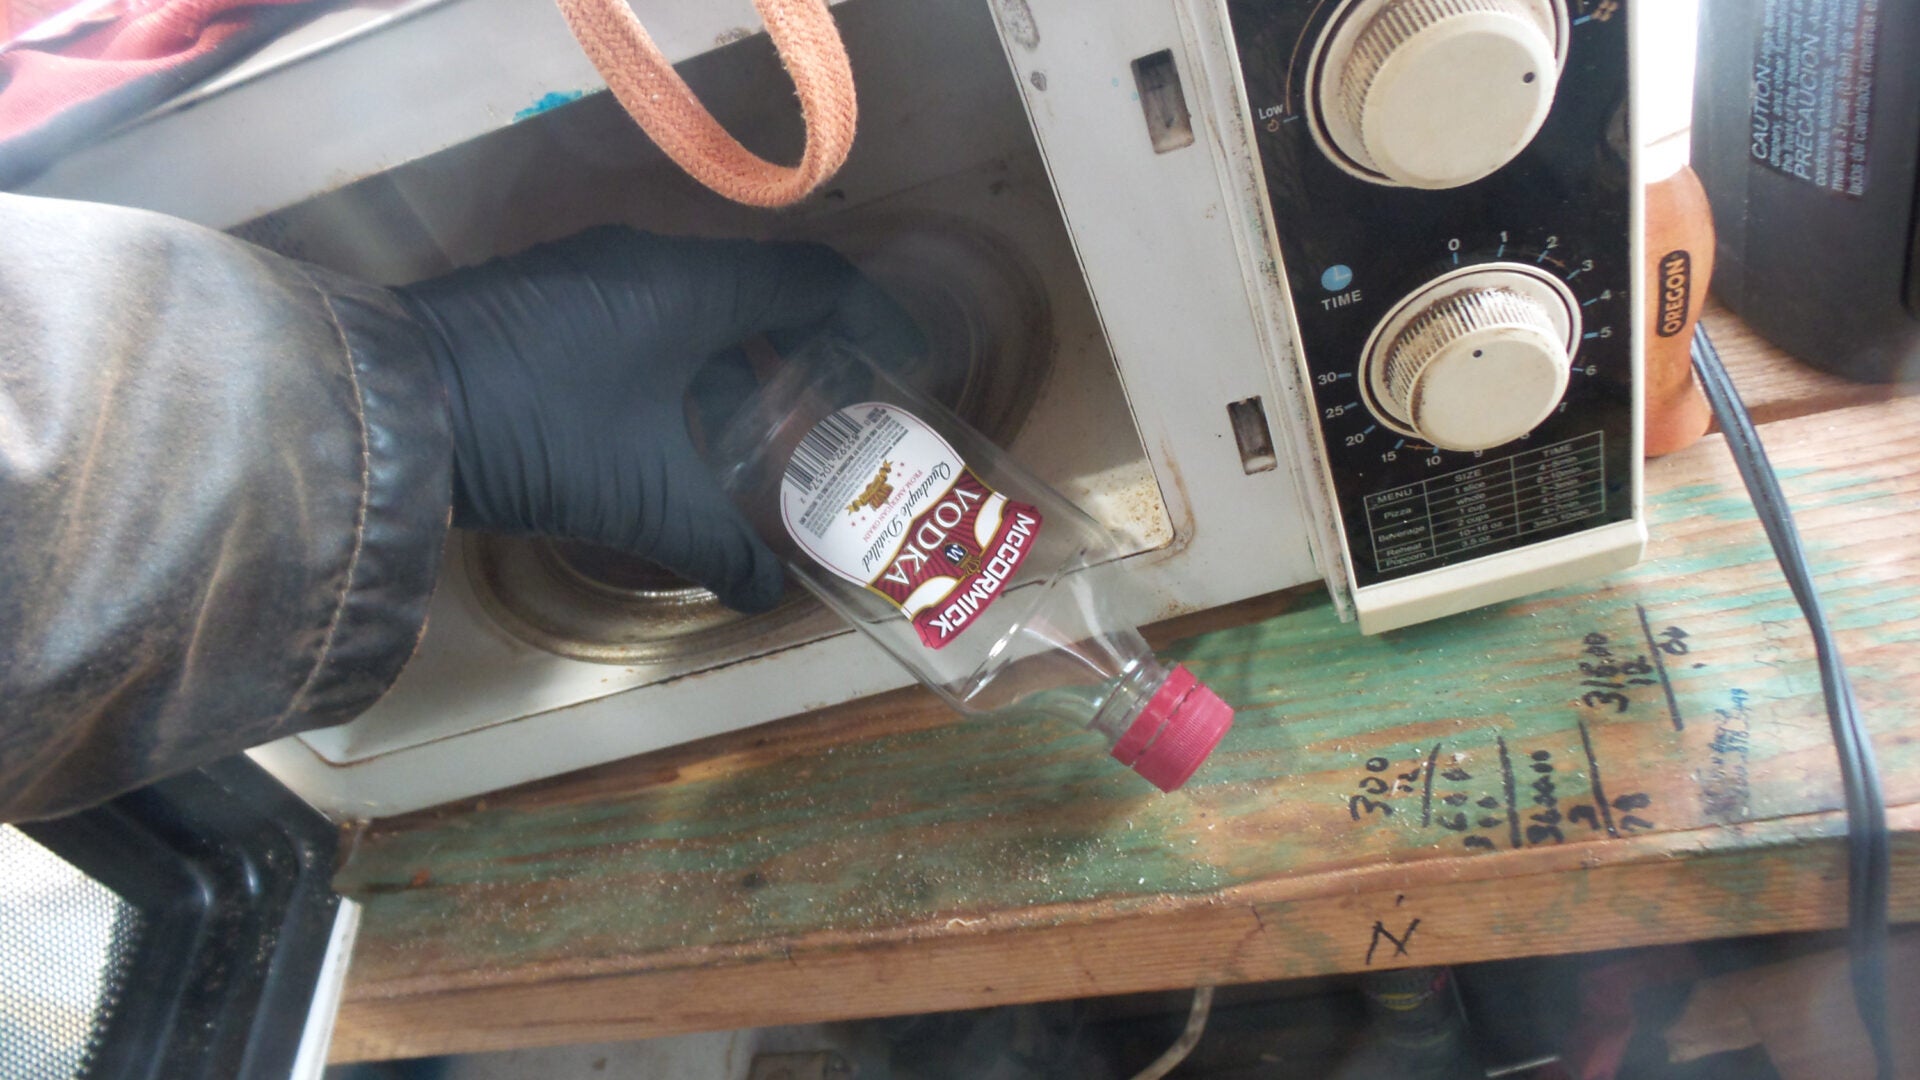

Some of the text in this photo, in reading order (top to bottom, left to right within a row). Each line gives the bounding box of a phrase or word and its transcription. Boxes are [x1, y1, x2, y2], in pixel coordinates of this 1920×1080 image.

[1258, 103, 1284, 121] Low
[1752, 64, 1771, 160] CAUTION
[1793, 32, 1820, 181] PRECAUCION
[1447, 238, 1461, 251] 0
[1500, 230, 1508, 244] 1
[1545, 235, 1559, 249] 2
[1581, 259, 1594, 272] 3
[1321, 289, 1363, 311] TIME
[1599, 289, 1613, 301] 4
[1663, 258, 1686, 333] OREGON
[1600, 326, 1612, 339] 5
[1585, 364, 1598, 377] 6
[1317, 371, 1337, 386] 30
[1325, 406, 1345, 419] 25
[1345, 432, 1365, 447] 20
[1381, 451, 1397, 463] 15
[1543, 443, 1573, 458] TIME
[1425, 455, 1442, 467] 10
[1454, 468, 1483, 483] SIZE
[1463, 480, 1487, 493] slice
[1377, 487, 1414, 504] MENU
[1455, 491, 1487, 506] whole
[863, 469, 923, 543] FROM AMERICAN GRAIN
[1383, 506, 1413, 520] Pizza
[1467, 503, 1487, 514] cup
[862, 461, 951, 574] Quadruple Distilled
[1466, 512, 1490, 526] cups
[1490, 520, 1504, 530] oz
[884, 487, 982, 586] VODKA
[1378, 525, 1426, 543] Beverage
[1386, 541, 1422, 557] Reheat
[1386, 551, 1427, 567] Popcorn
[1350, 757, 1394, 821] 300
